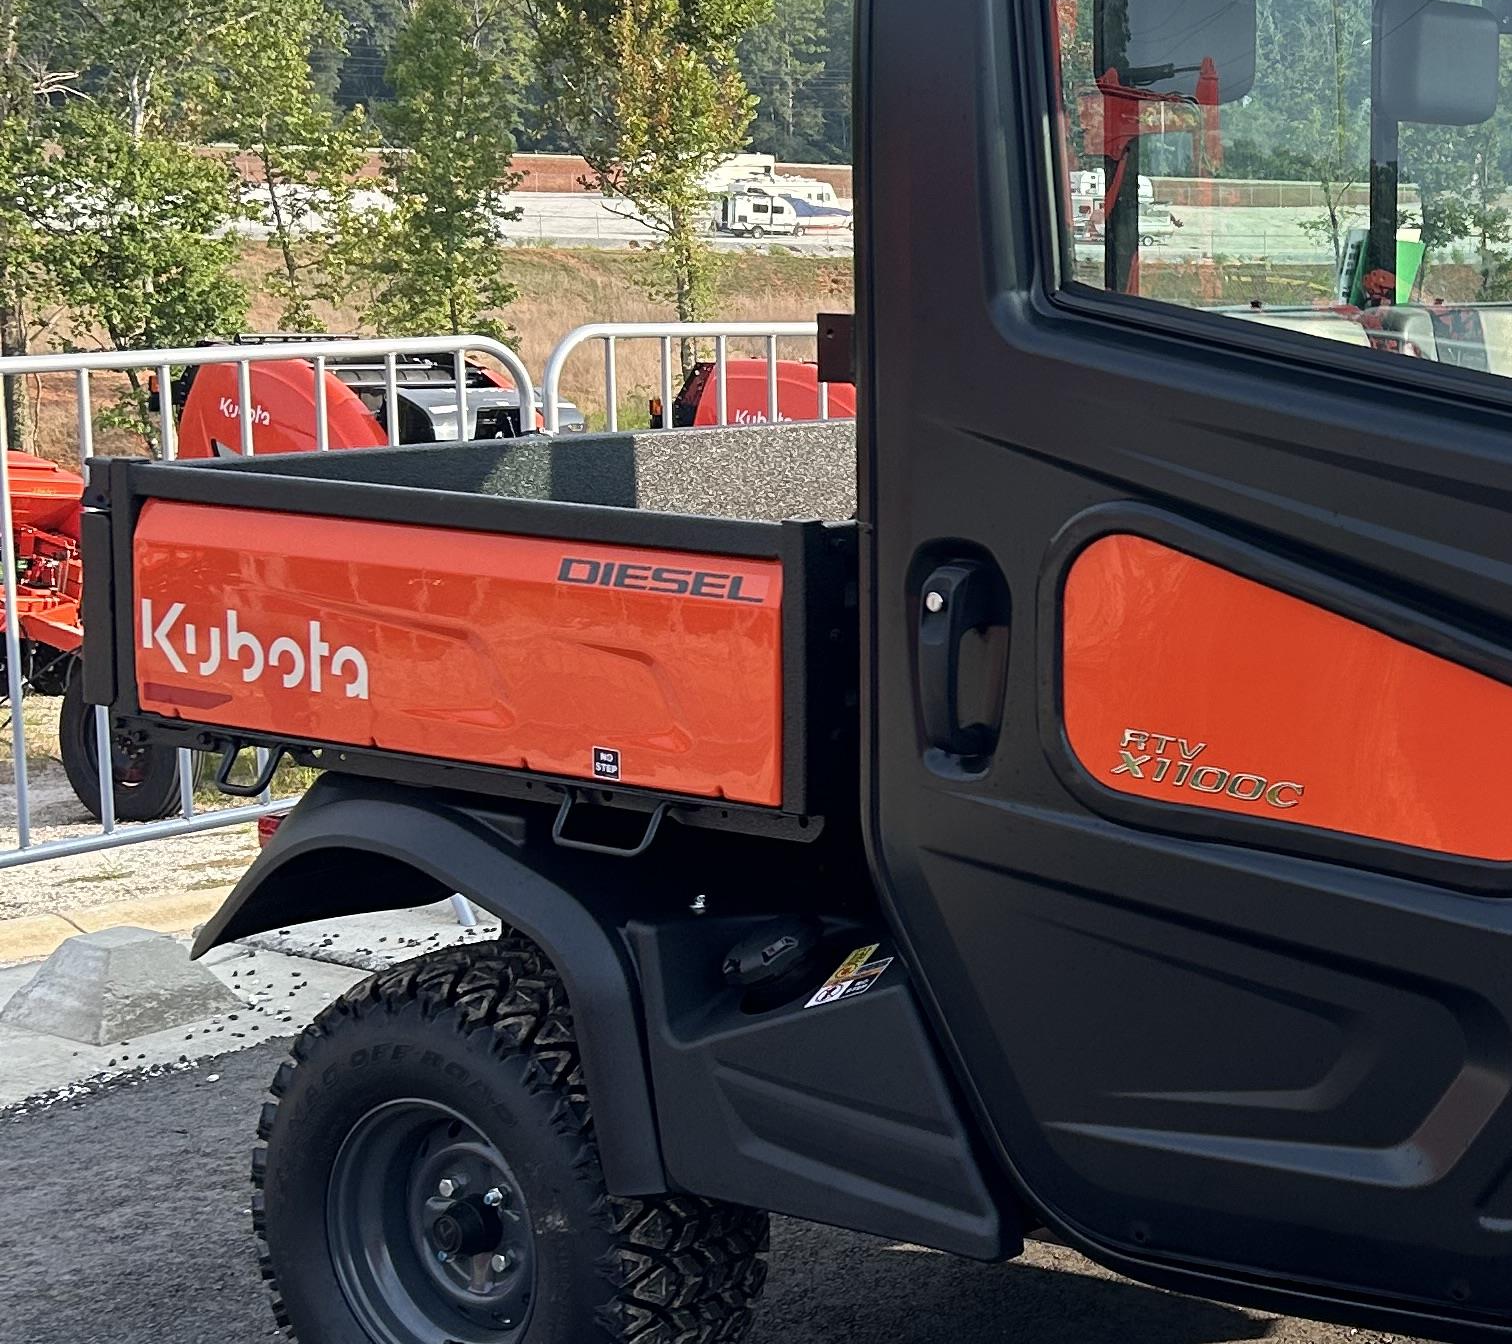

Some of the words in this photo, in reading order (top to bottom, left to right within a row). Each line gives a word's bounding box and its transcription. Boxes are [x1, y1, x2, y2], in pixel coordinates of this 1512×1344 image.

[219, 397, 271, 425] Kuota
[557, 557, 764, 603] DIESEL
[141, 598, 369, 700] Kubota
[600, 752, 614, 762] NO
[1120, 728, 1208, 760] RTV
[595, 761, 618, 774] STEP
[1110, 749, 1305, 808] X1100C
